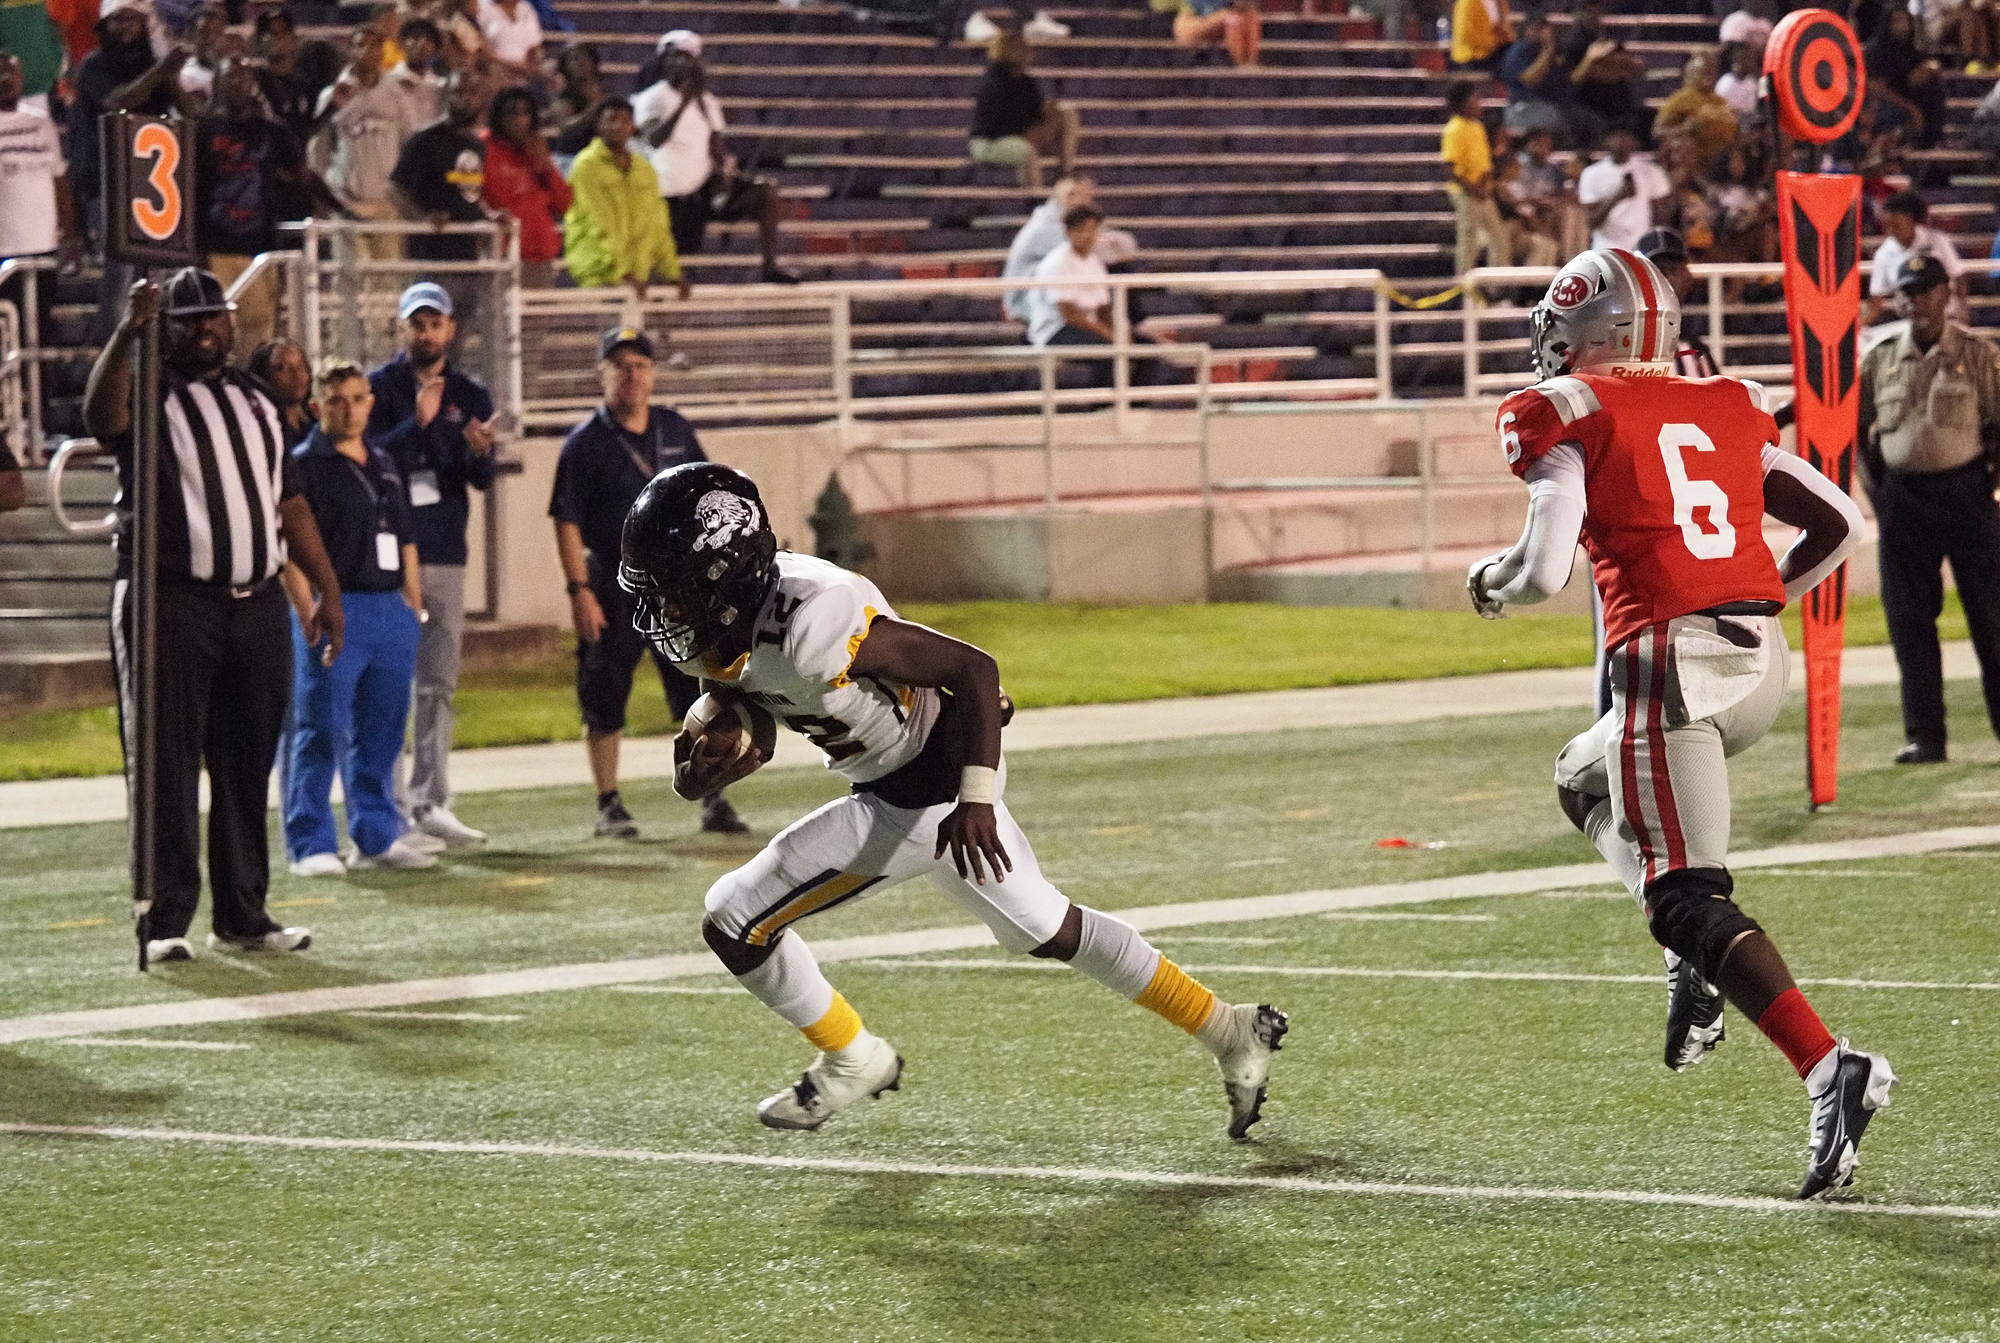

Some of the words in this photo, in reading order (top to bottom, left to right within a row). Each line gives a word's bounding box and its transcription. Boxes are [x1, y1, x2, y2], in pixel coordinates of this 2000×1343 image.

[132, 123, 181, 240] 3
[1621, 335, 1630, 348] 6
[1499, 411, 1522, 464] 6
[1657, 423, 1736, 560] 6
